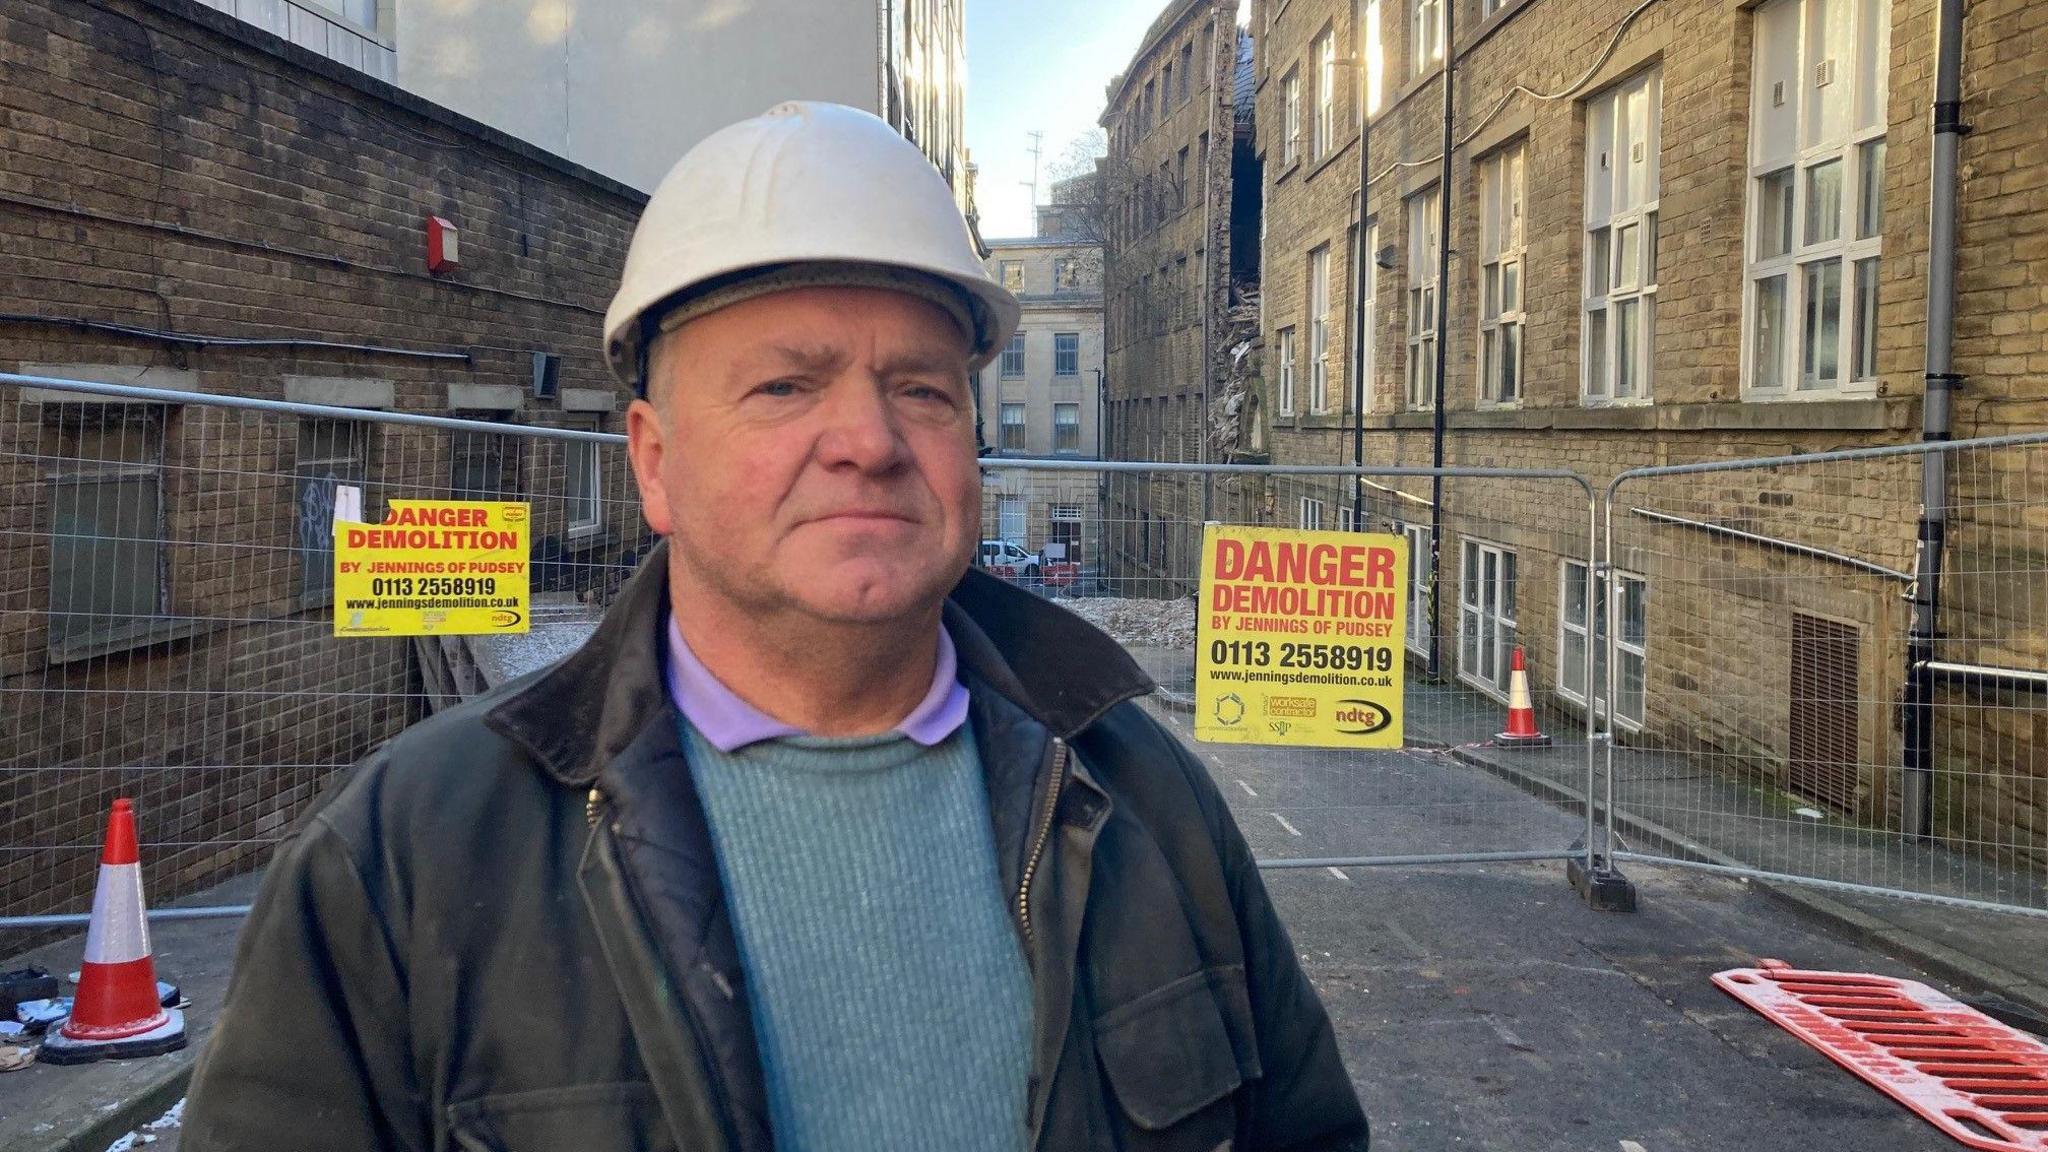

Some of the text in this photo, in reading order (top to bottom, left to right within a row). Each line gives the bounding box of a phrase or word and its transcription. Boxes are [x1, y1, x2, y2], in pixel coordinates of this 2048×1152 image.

[348, 529, 518, 550] DEMOLITION
[340, 562, 525, 574] BY JENNINGS OF PUDSEY
[1214, 538, 1396, 589] DANGER
[372, 577, 496, 596] 0113 2558919
[346, 596, 519, 610] www.jenningsdemolition.co.uk
[1212, 583, 1396, 620] DEMOLITION
[1211, 615, 1393, 638] BY JENNINGS OF PUDSEY
[1211, 639, 1393, 672] 0113 2558919
[1209, 669, 1393, 687] www.jenningsdemolition.co.uk
[1335, 707, 1375, 727] ndtg
